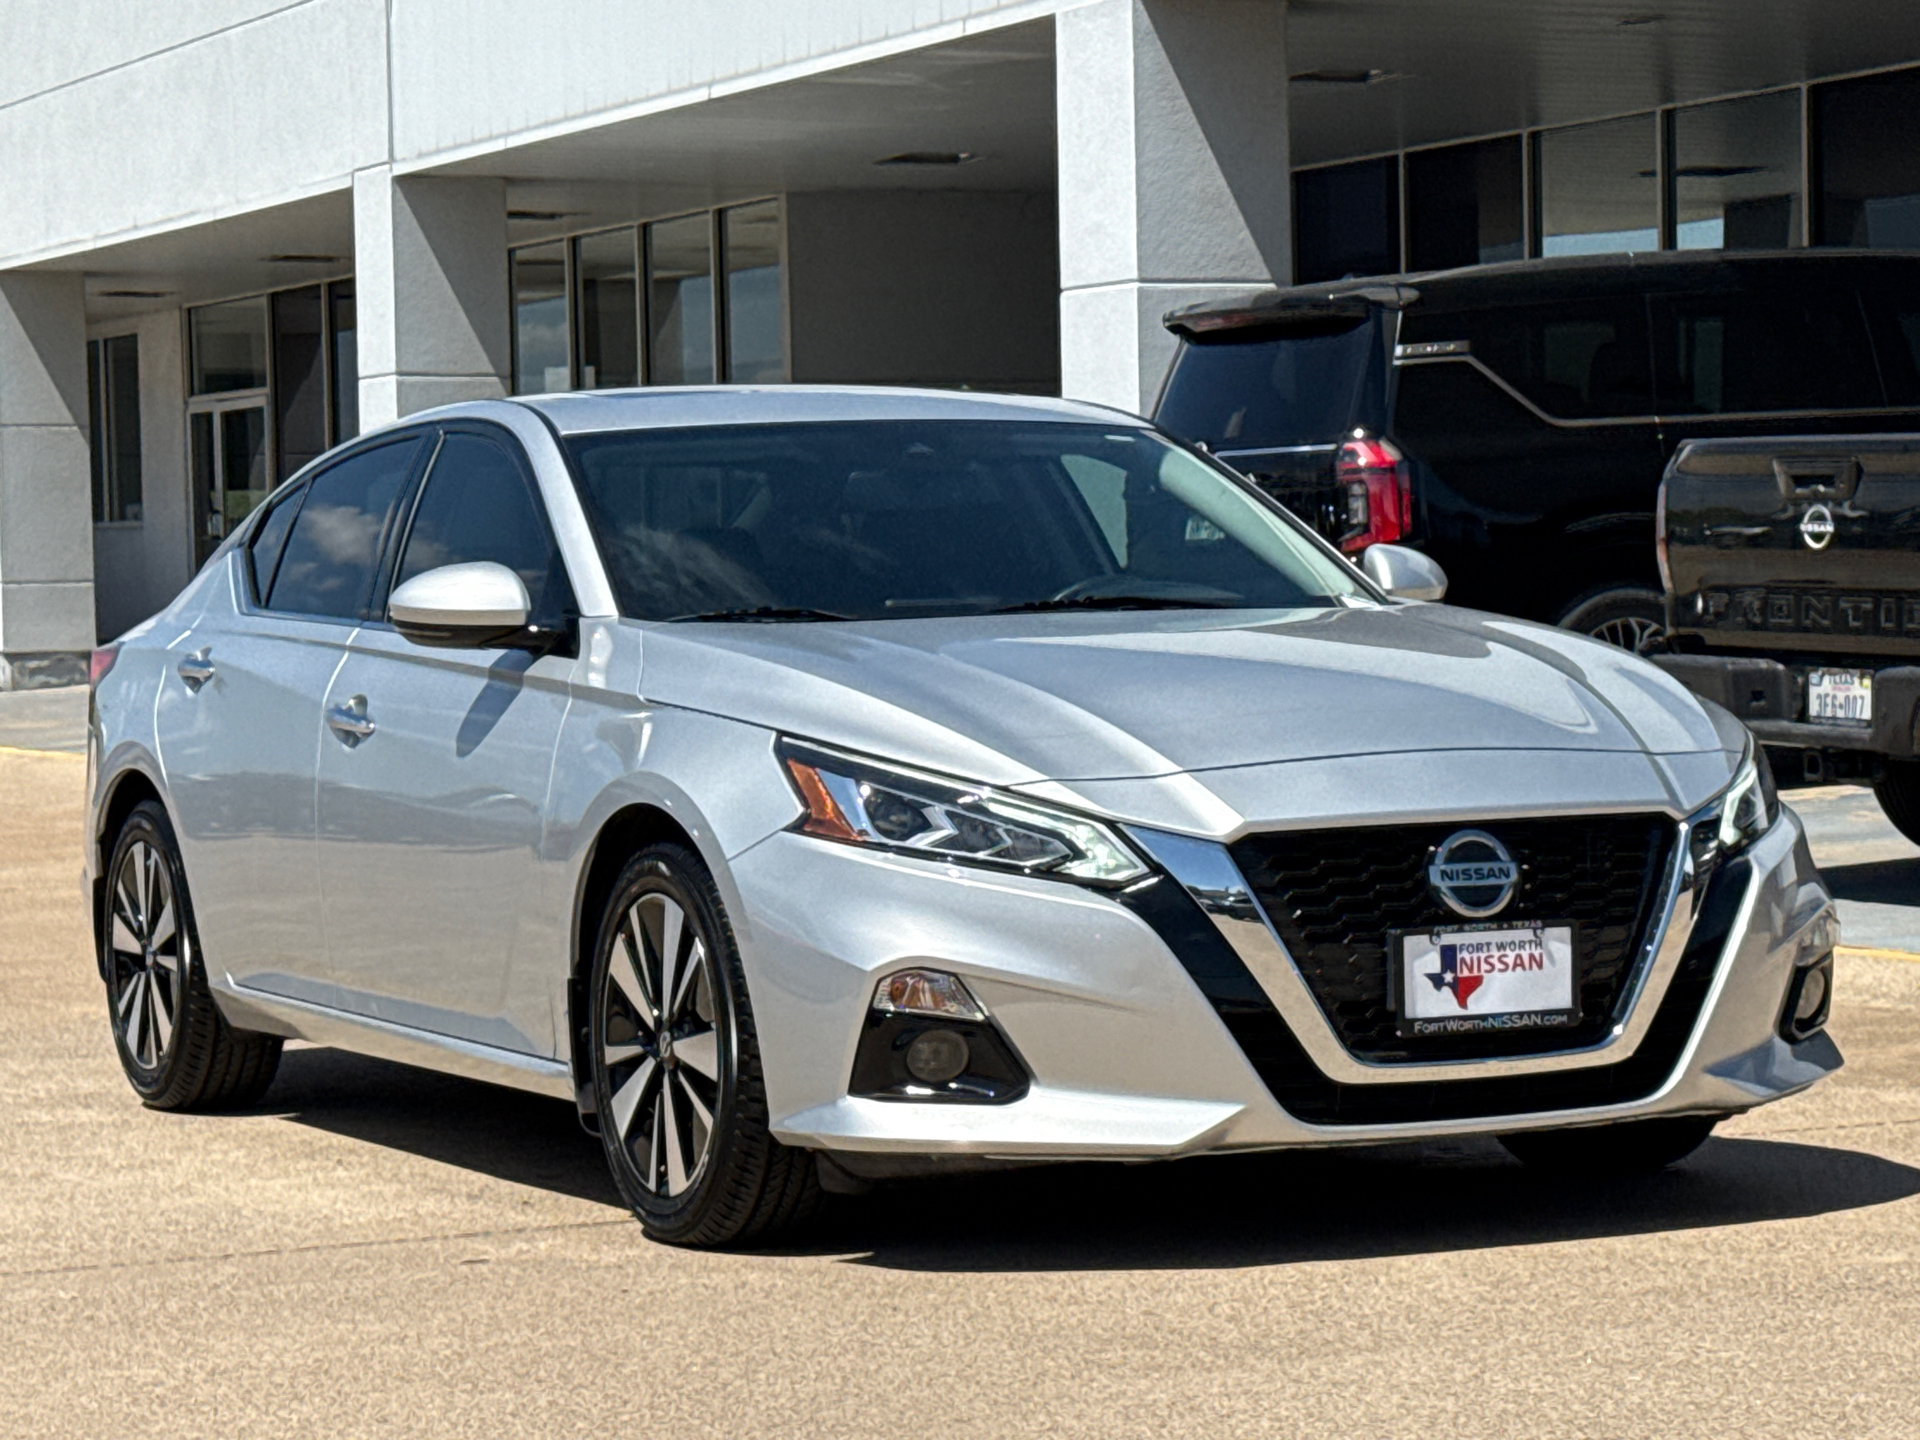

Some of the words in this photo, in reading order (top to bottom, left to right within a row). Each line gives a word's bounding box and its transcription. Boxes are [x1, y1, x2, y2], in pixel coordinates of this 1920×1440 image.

[1440, 866, 1511, 881] NISSAN
[1458, 941, 1493, 955] FORT
[1495, 939, 1543, 952] WORTH
[1459, 952, 1544, 975] NISSAN
